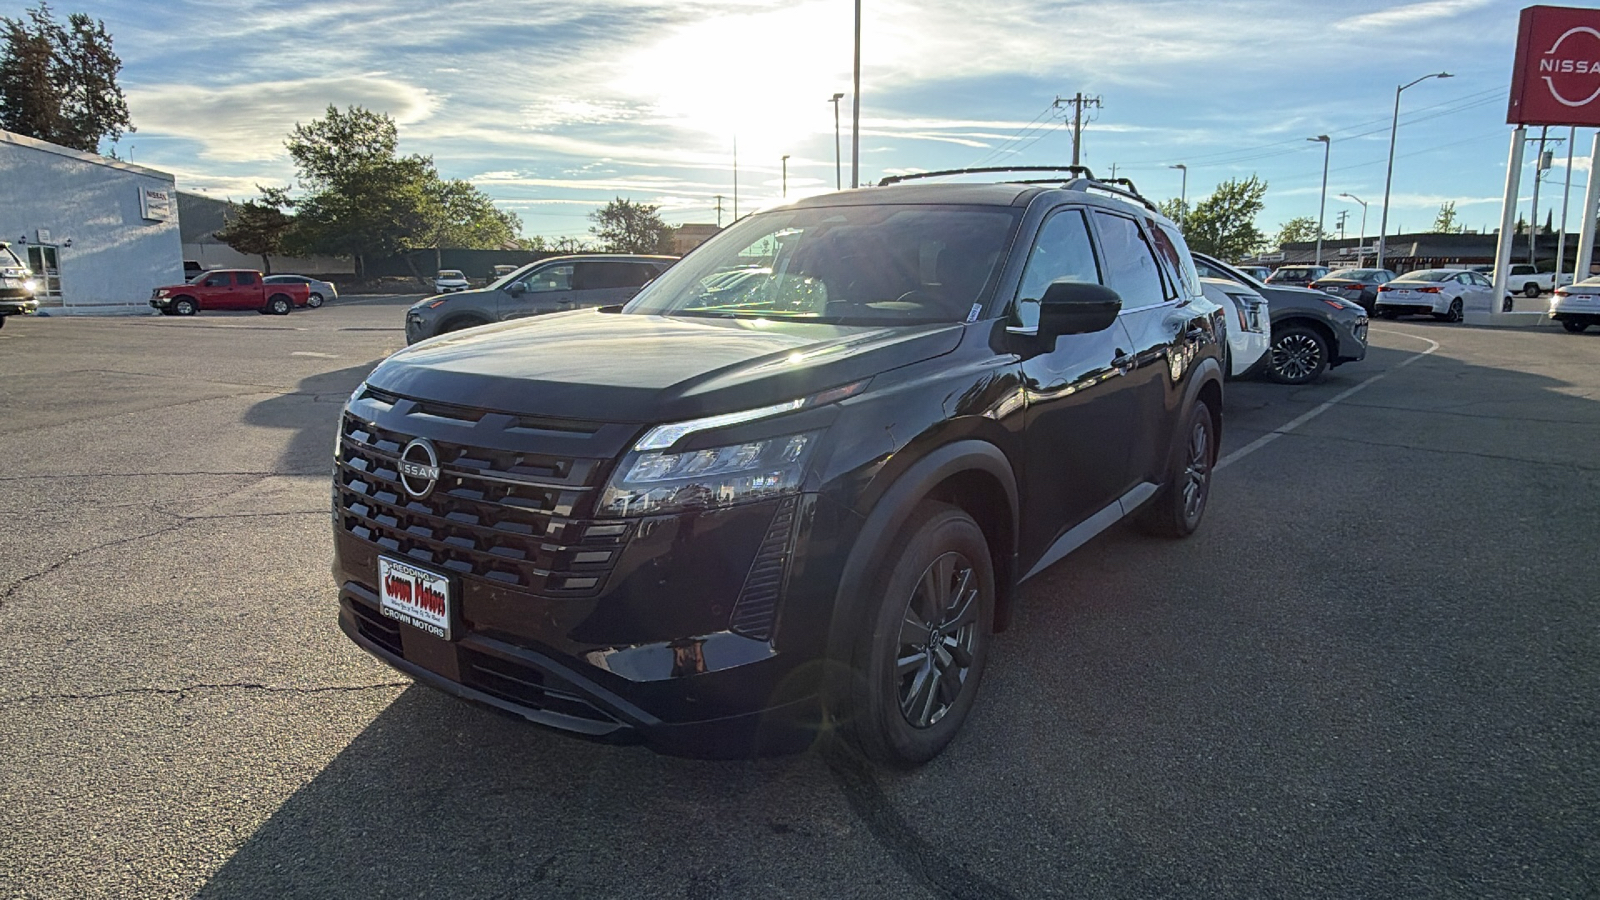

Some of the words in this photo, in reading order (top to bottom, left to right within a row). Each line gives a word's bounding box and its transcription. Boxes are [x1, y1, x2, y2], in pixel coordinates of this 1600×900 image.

[1540, 59, 1600, 74] NISSA
[397, 461, 438, 479] NISSAN
[393, 563, 430, 580] REDDING
[384, 573, 412, 604] Crown
[414, 577, 446, 617] Motors
[384, 607, 411, 625] CROWN
[412, 618, 444, 638] MOTORS
